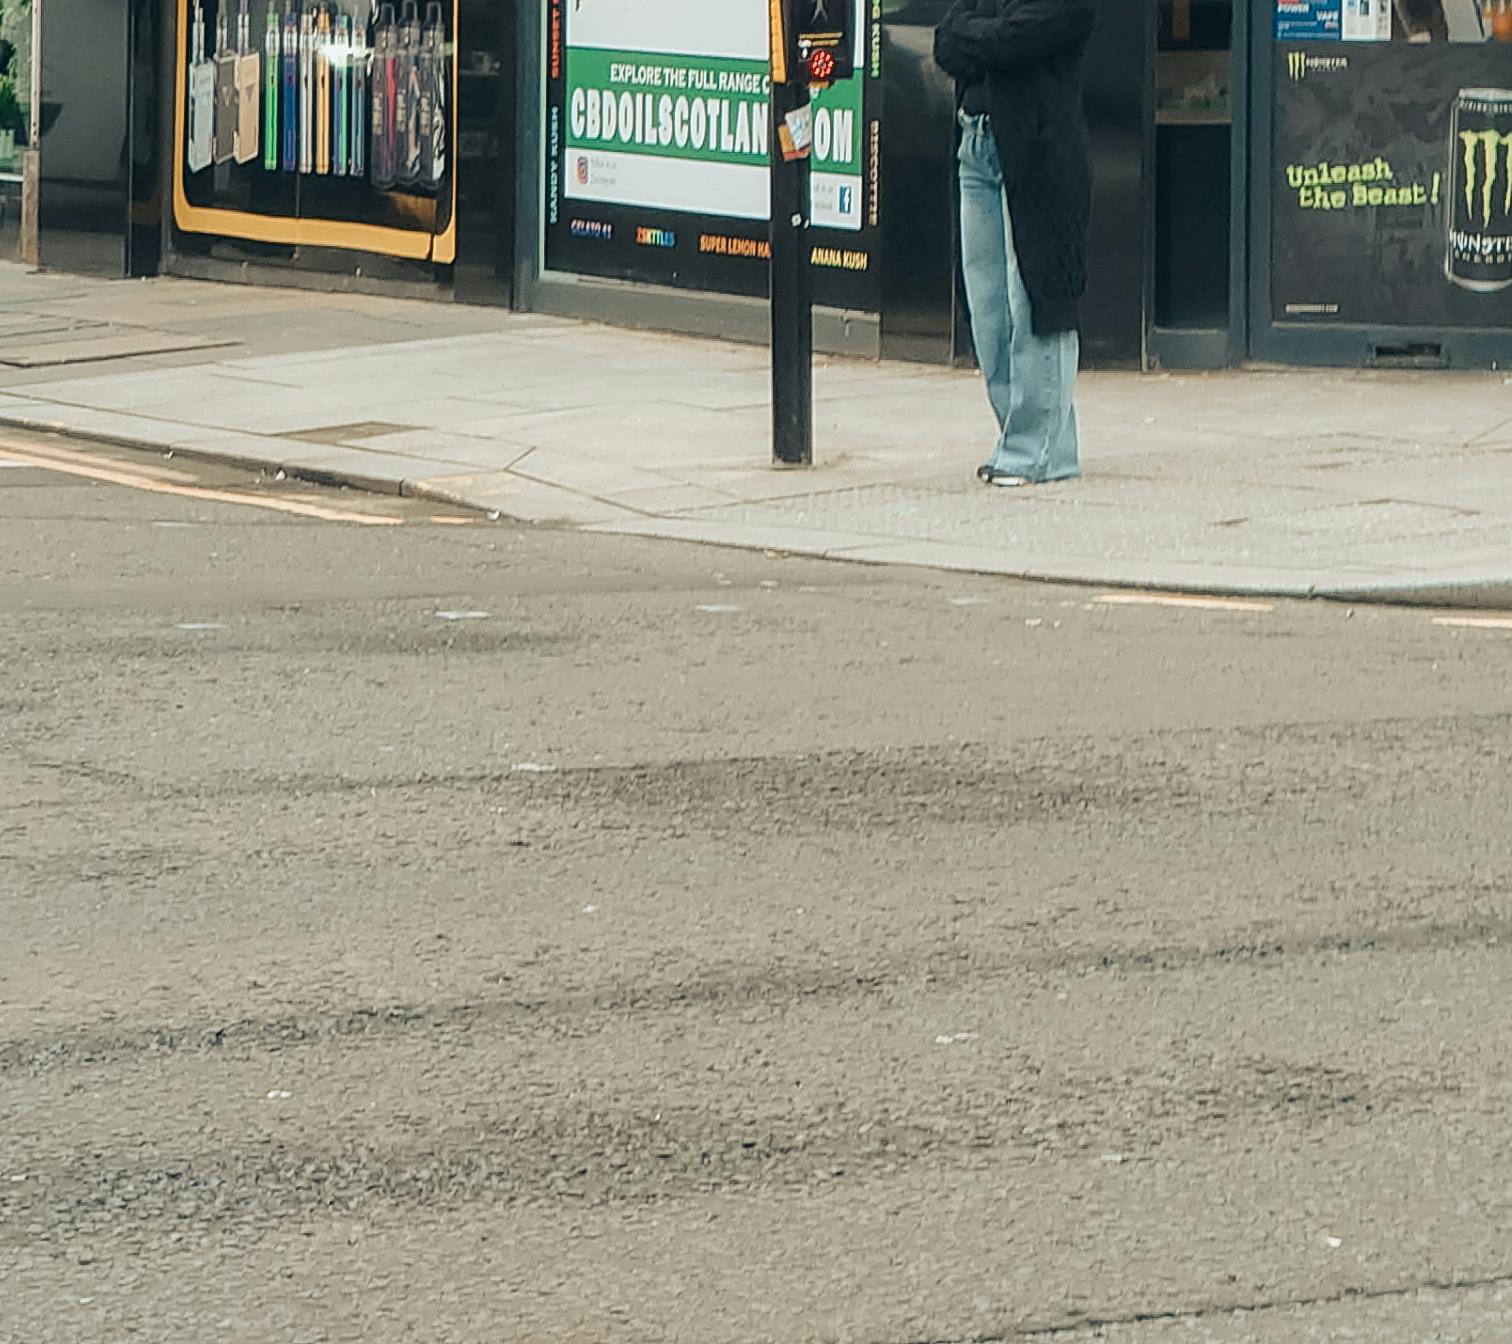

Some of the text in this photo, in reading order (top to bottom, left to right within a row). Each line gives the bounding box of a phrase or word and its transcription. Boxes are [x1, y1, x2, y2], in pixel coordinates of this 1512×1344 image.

[610, 63, 662, 87] EXPLORE
[663, 66, 686, 88] THE
[688, 68, 717, 90] FULL
[719, 71, 761, 93] RANGE
[1286, 156, 1393, 188] Unleash
[1299, 185, 1346, 210] the
[700, 234, 725, 255] SUPER
[728, 236, 757, 257] LEMON
[811, 247, 867, 271] ANANA KUSH
